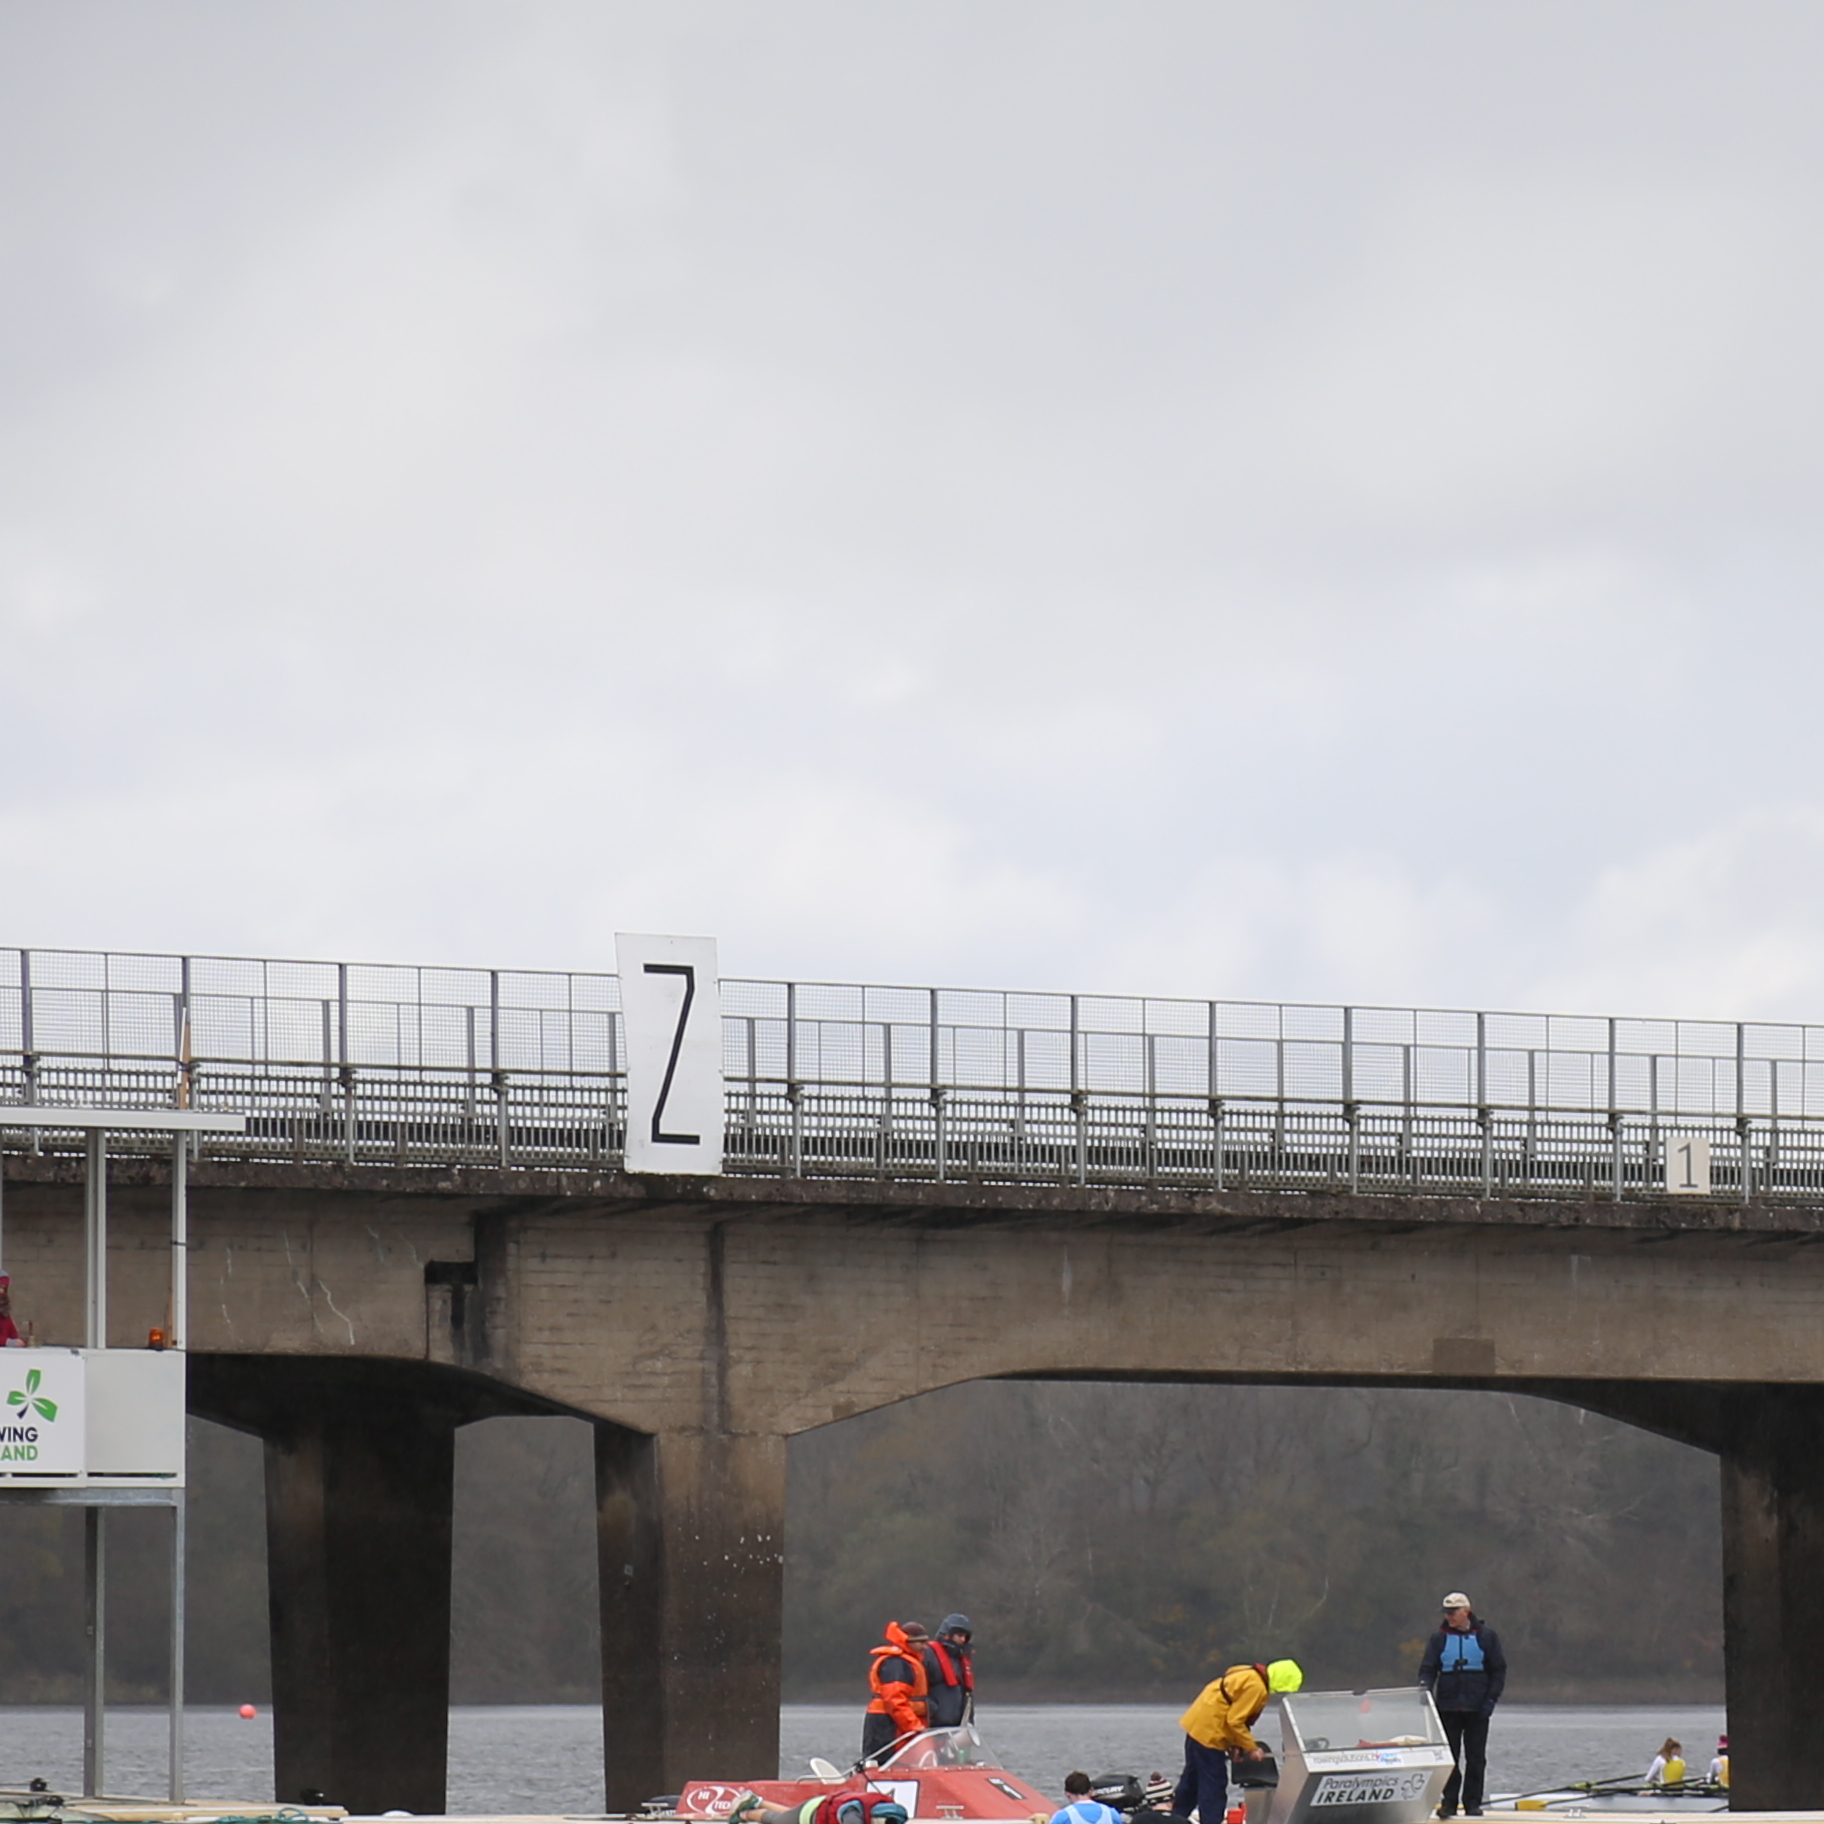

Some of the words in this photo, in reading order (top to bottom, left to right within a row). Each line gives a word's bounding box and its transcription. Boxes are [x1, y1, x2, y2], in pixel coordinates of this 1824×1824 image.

[1678, 1142, 1698, 1188] 1
[1323, 1773, 1399, 1790] Paralympics
[1317, 1788, 1394, 1803] IRELAND
[714, 1801, 731, 1810] TEC
